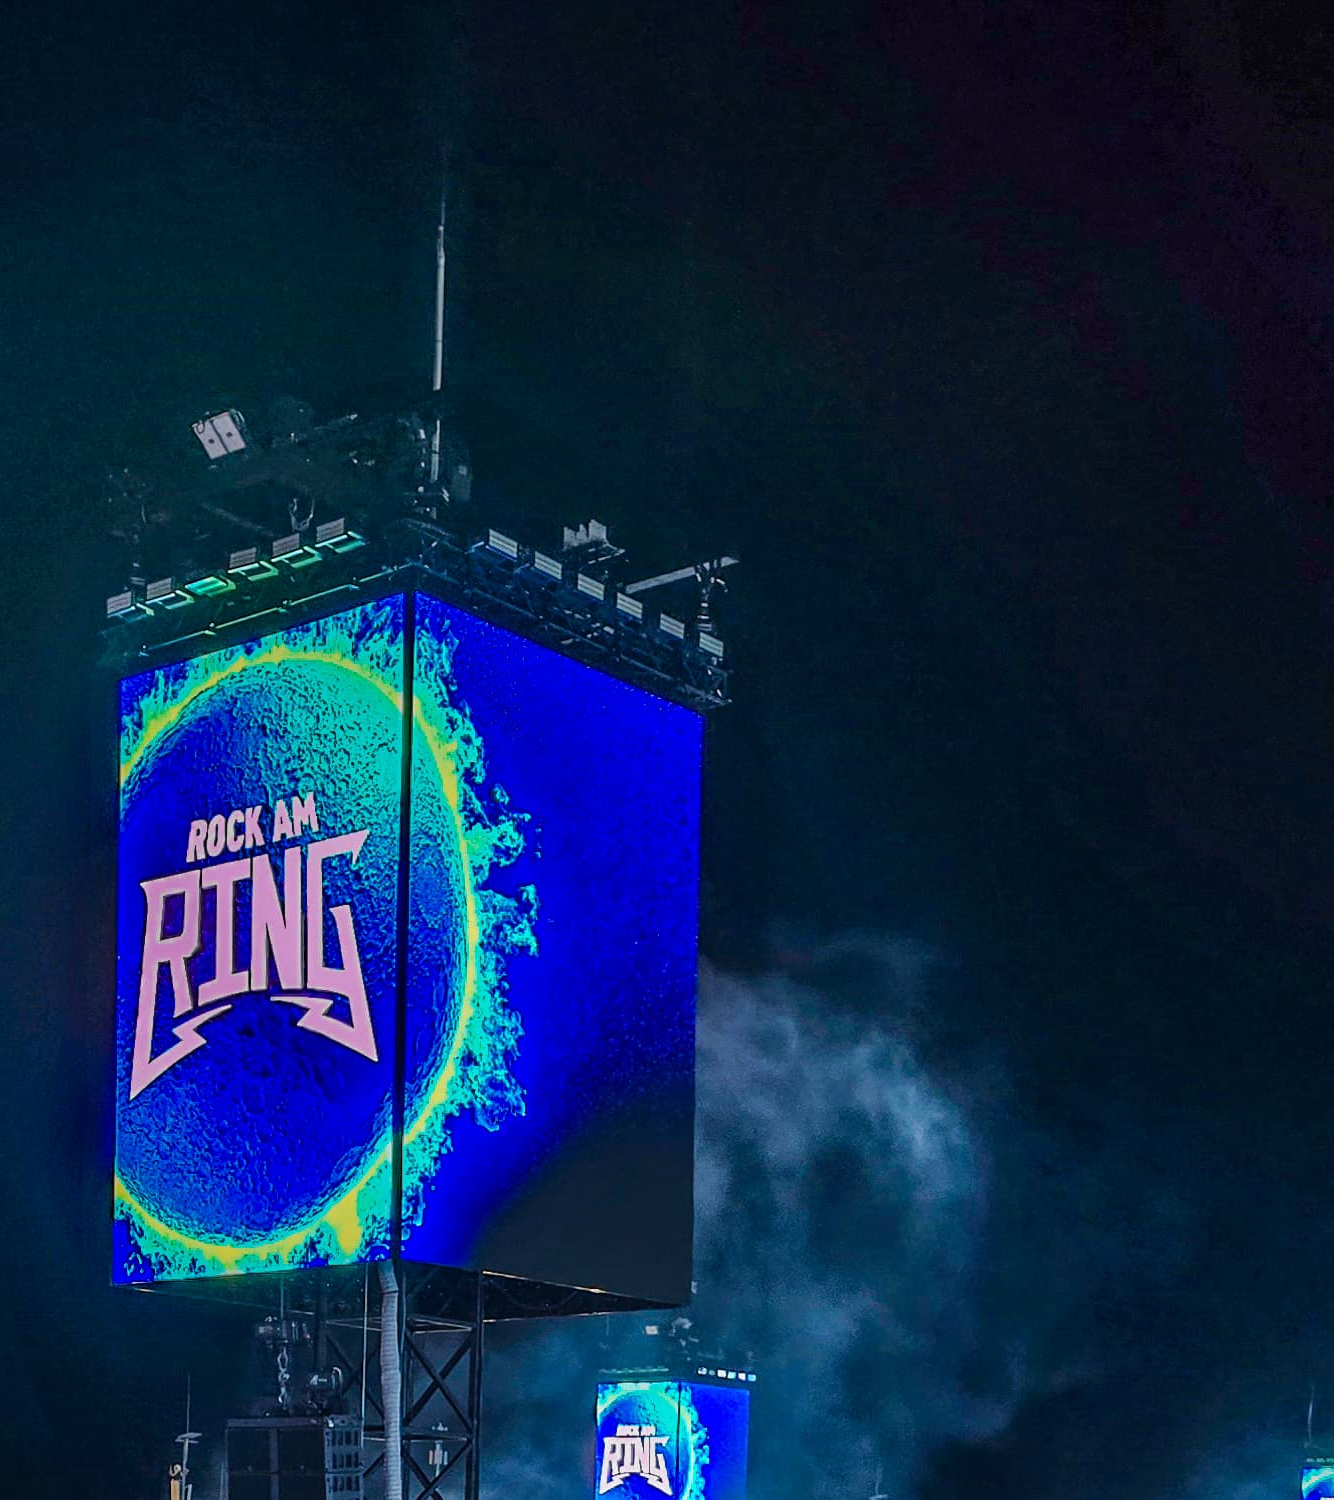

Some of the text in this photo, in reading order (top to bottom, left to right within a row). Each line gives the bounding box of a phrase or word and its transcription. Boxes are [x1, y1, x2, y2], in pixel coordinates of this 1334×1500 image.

[186, 792, 320, 863] ROCK AM
[130, 829, 378, 1100] RING
[599, 1436, 674, 1496] RING
